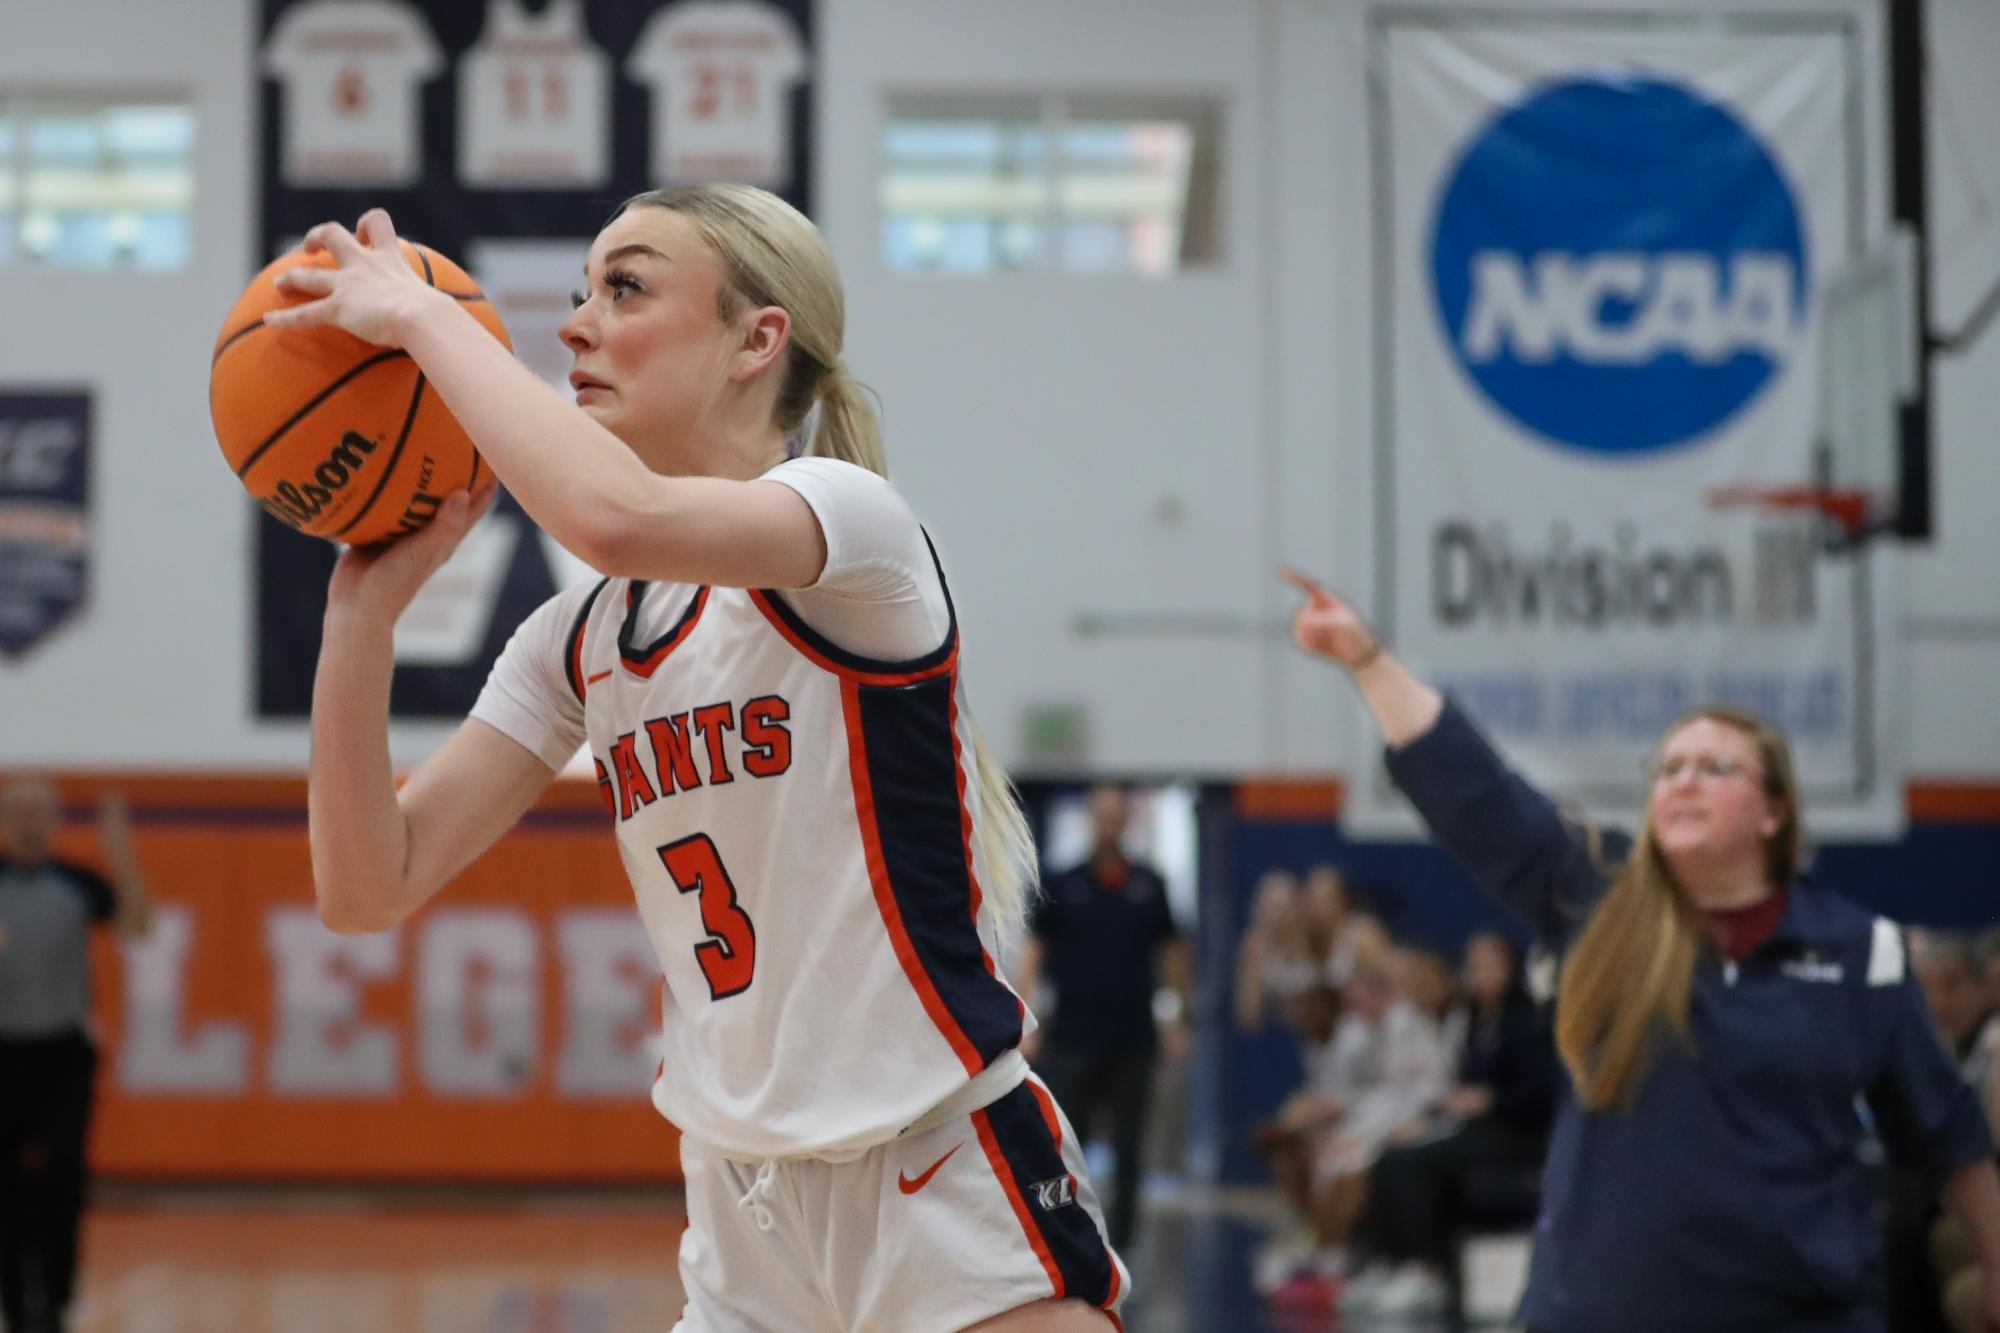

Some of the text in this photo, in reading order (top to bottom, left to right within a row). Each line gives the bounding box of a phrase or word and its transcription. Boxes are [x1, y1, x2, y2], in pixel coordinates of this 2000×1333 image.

[1463, 250, 1796, 364] NCAA
[1432, 518, 1732, 626] Division
[656, 832, 756, 1001] 3
